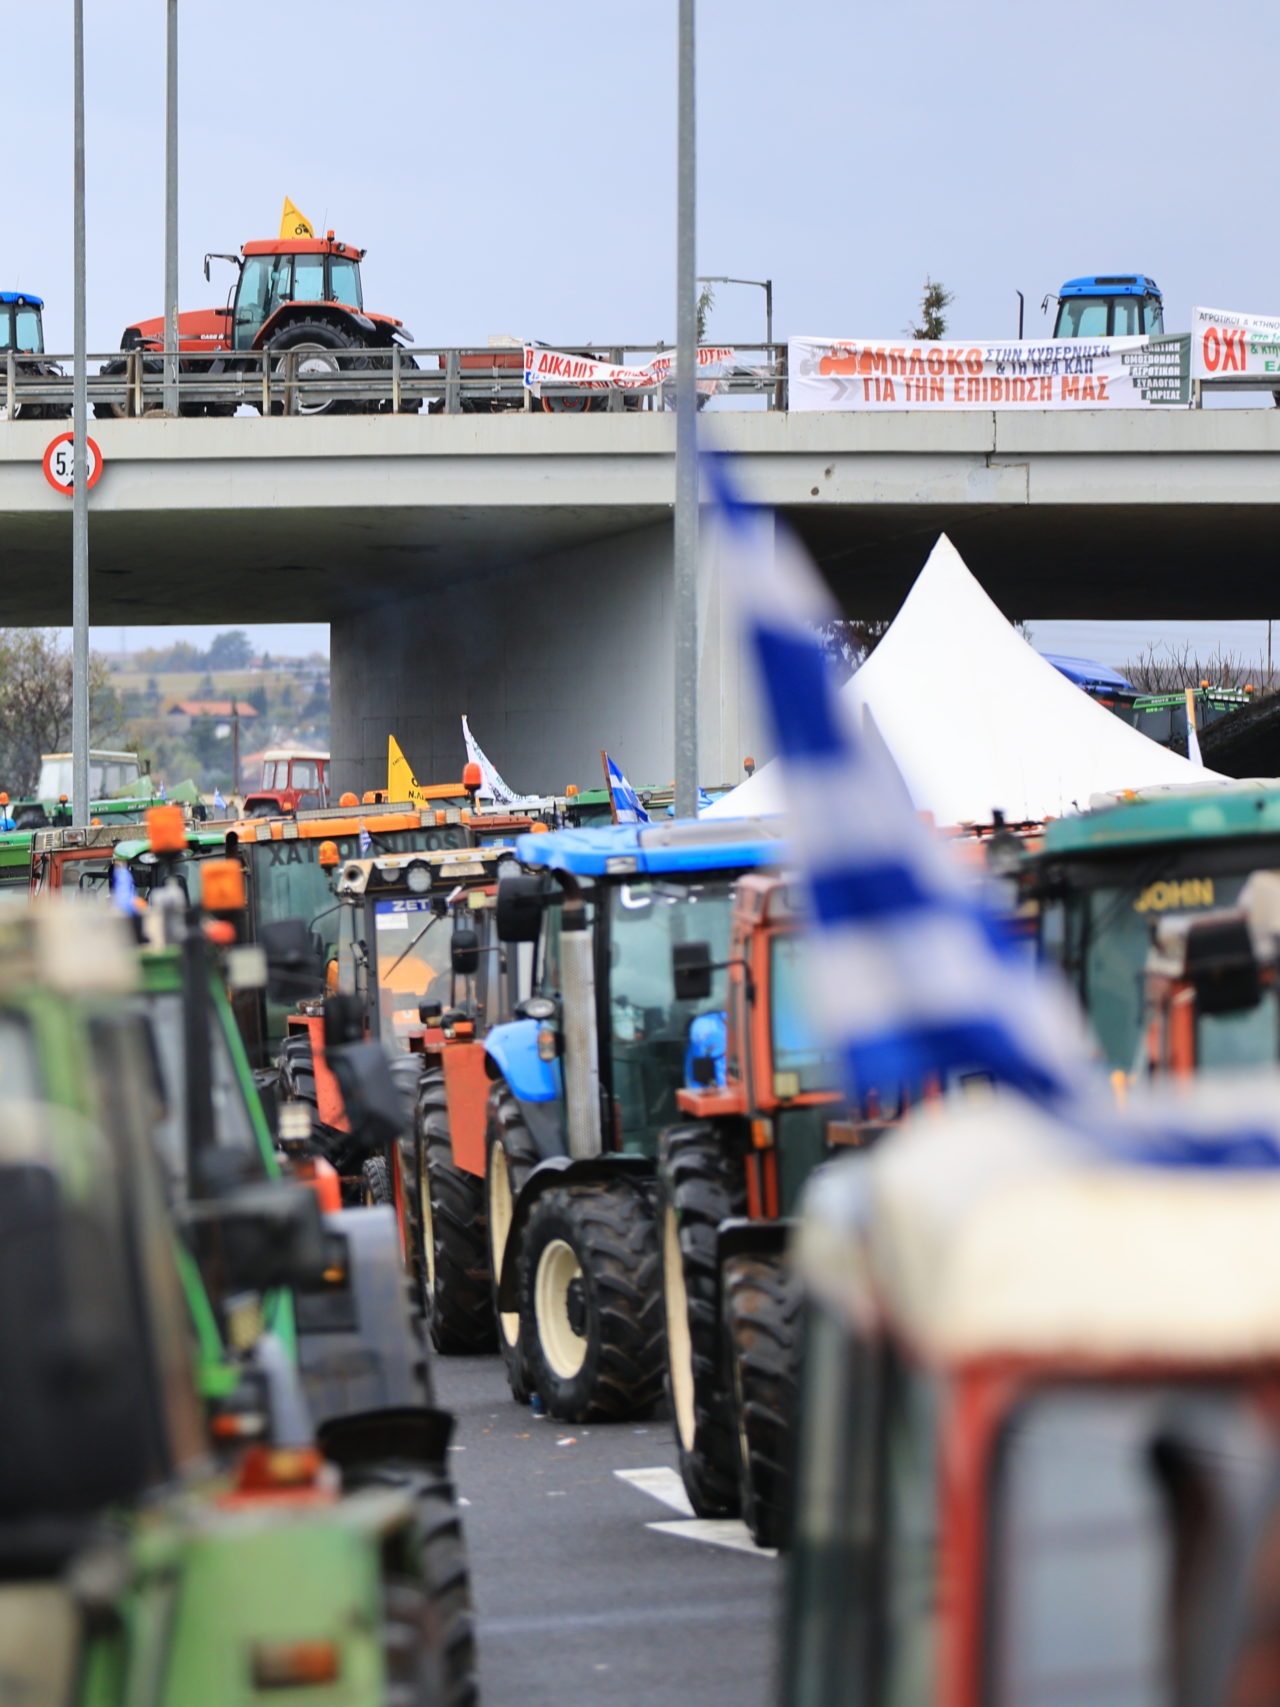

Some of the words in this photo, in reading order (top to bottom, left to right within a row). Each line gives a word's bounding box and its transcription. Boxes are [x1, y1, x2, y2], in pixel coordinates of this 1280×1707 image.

[985, 348, 1023, 362] ΣΤΗΝ
[1203, 327, 1246, 372] ΟΧΙ
[862, 347, 983, 376] ΜΠΛΟΚΟ
[995, 361, 1006, 375] &
[1010, 361, 1027, 375] ΤΗ
[1032, 360, 1060, 375] ΝΕΑ
[1064, 358, 1094, 374] ΚΑΠ
[1124, 354, 1180, 365] ΟΜΟΣΠΟΝΔΙΑ
[863, 377, 896, 402] ΓΙΑ
[904, 377, 944, 402] ΤΗΝ
[953, 376, 1053, 402] ΕΠΙΒΙΩΣΗ
[1060, 375, 1110, 401] ΜΑΣ
[1136, 378, 1180, 388] ΣΥΛΛΟΓΩΝ
[1145, 390, 1180, 400] ΛΑΡΙΣΑΣ
[1134, 878, 1214, 912] JOHN
[392, 898, 430, 912] ZET
